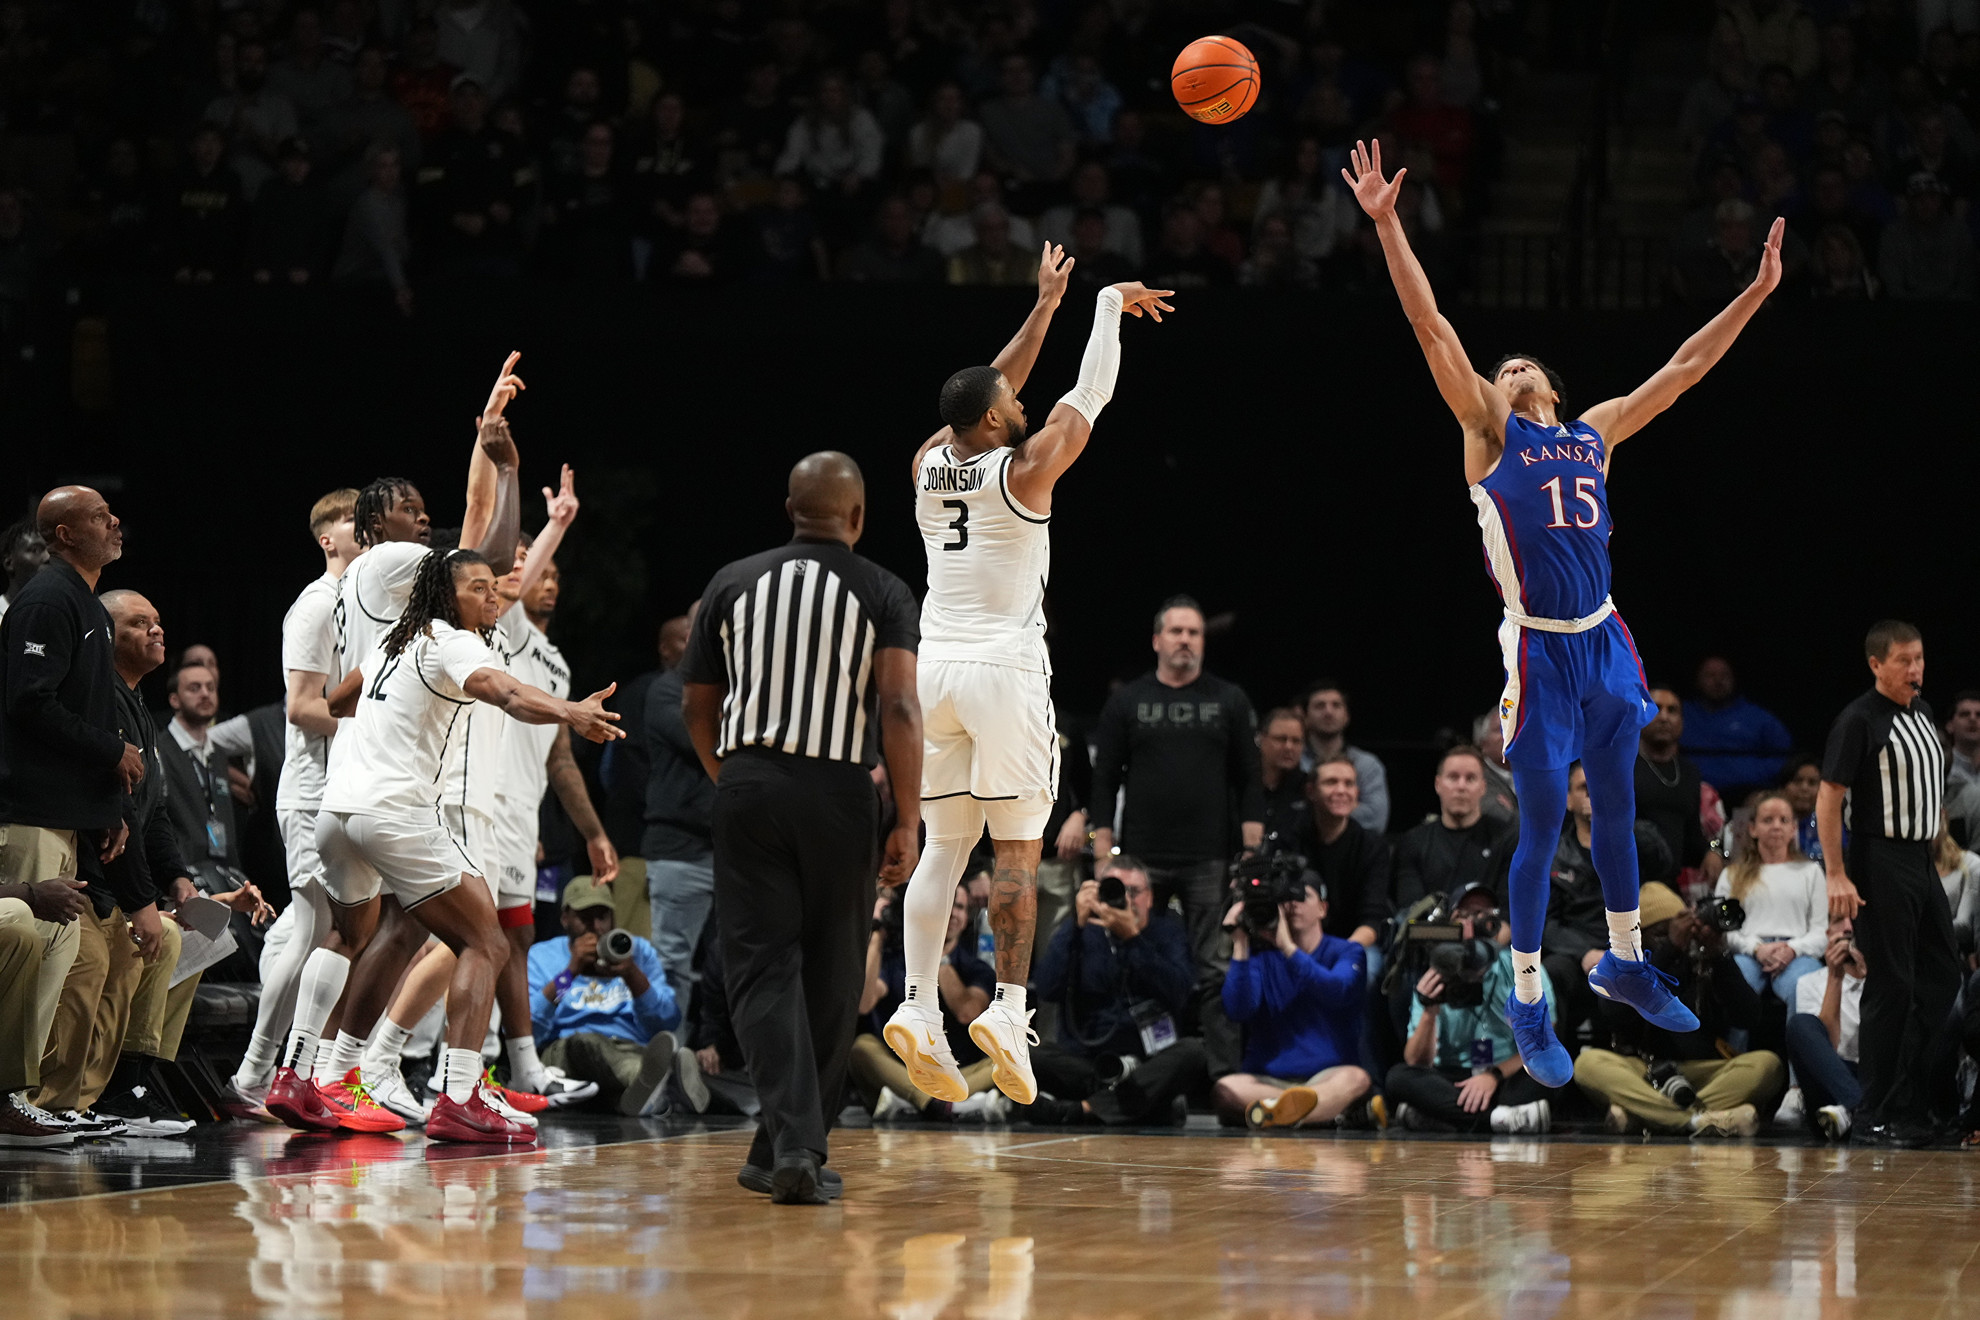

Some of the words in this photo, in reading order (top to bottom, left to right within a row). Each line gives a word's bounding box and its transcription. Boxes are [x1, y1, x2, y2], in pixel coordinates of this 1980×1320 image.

[924, 467, 986, 492] JOHNSON
[1540, 476, 1600, 529] 15
[942, 499, 969, 551] 3
[1137, 702, 1221, 724] UCF
